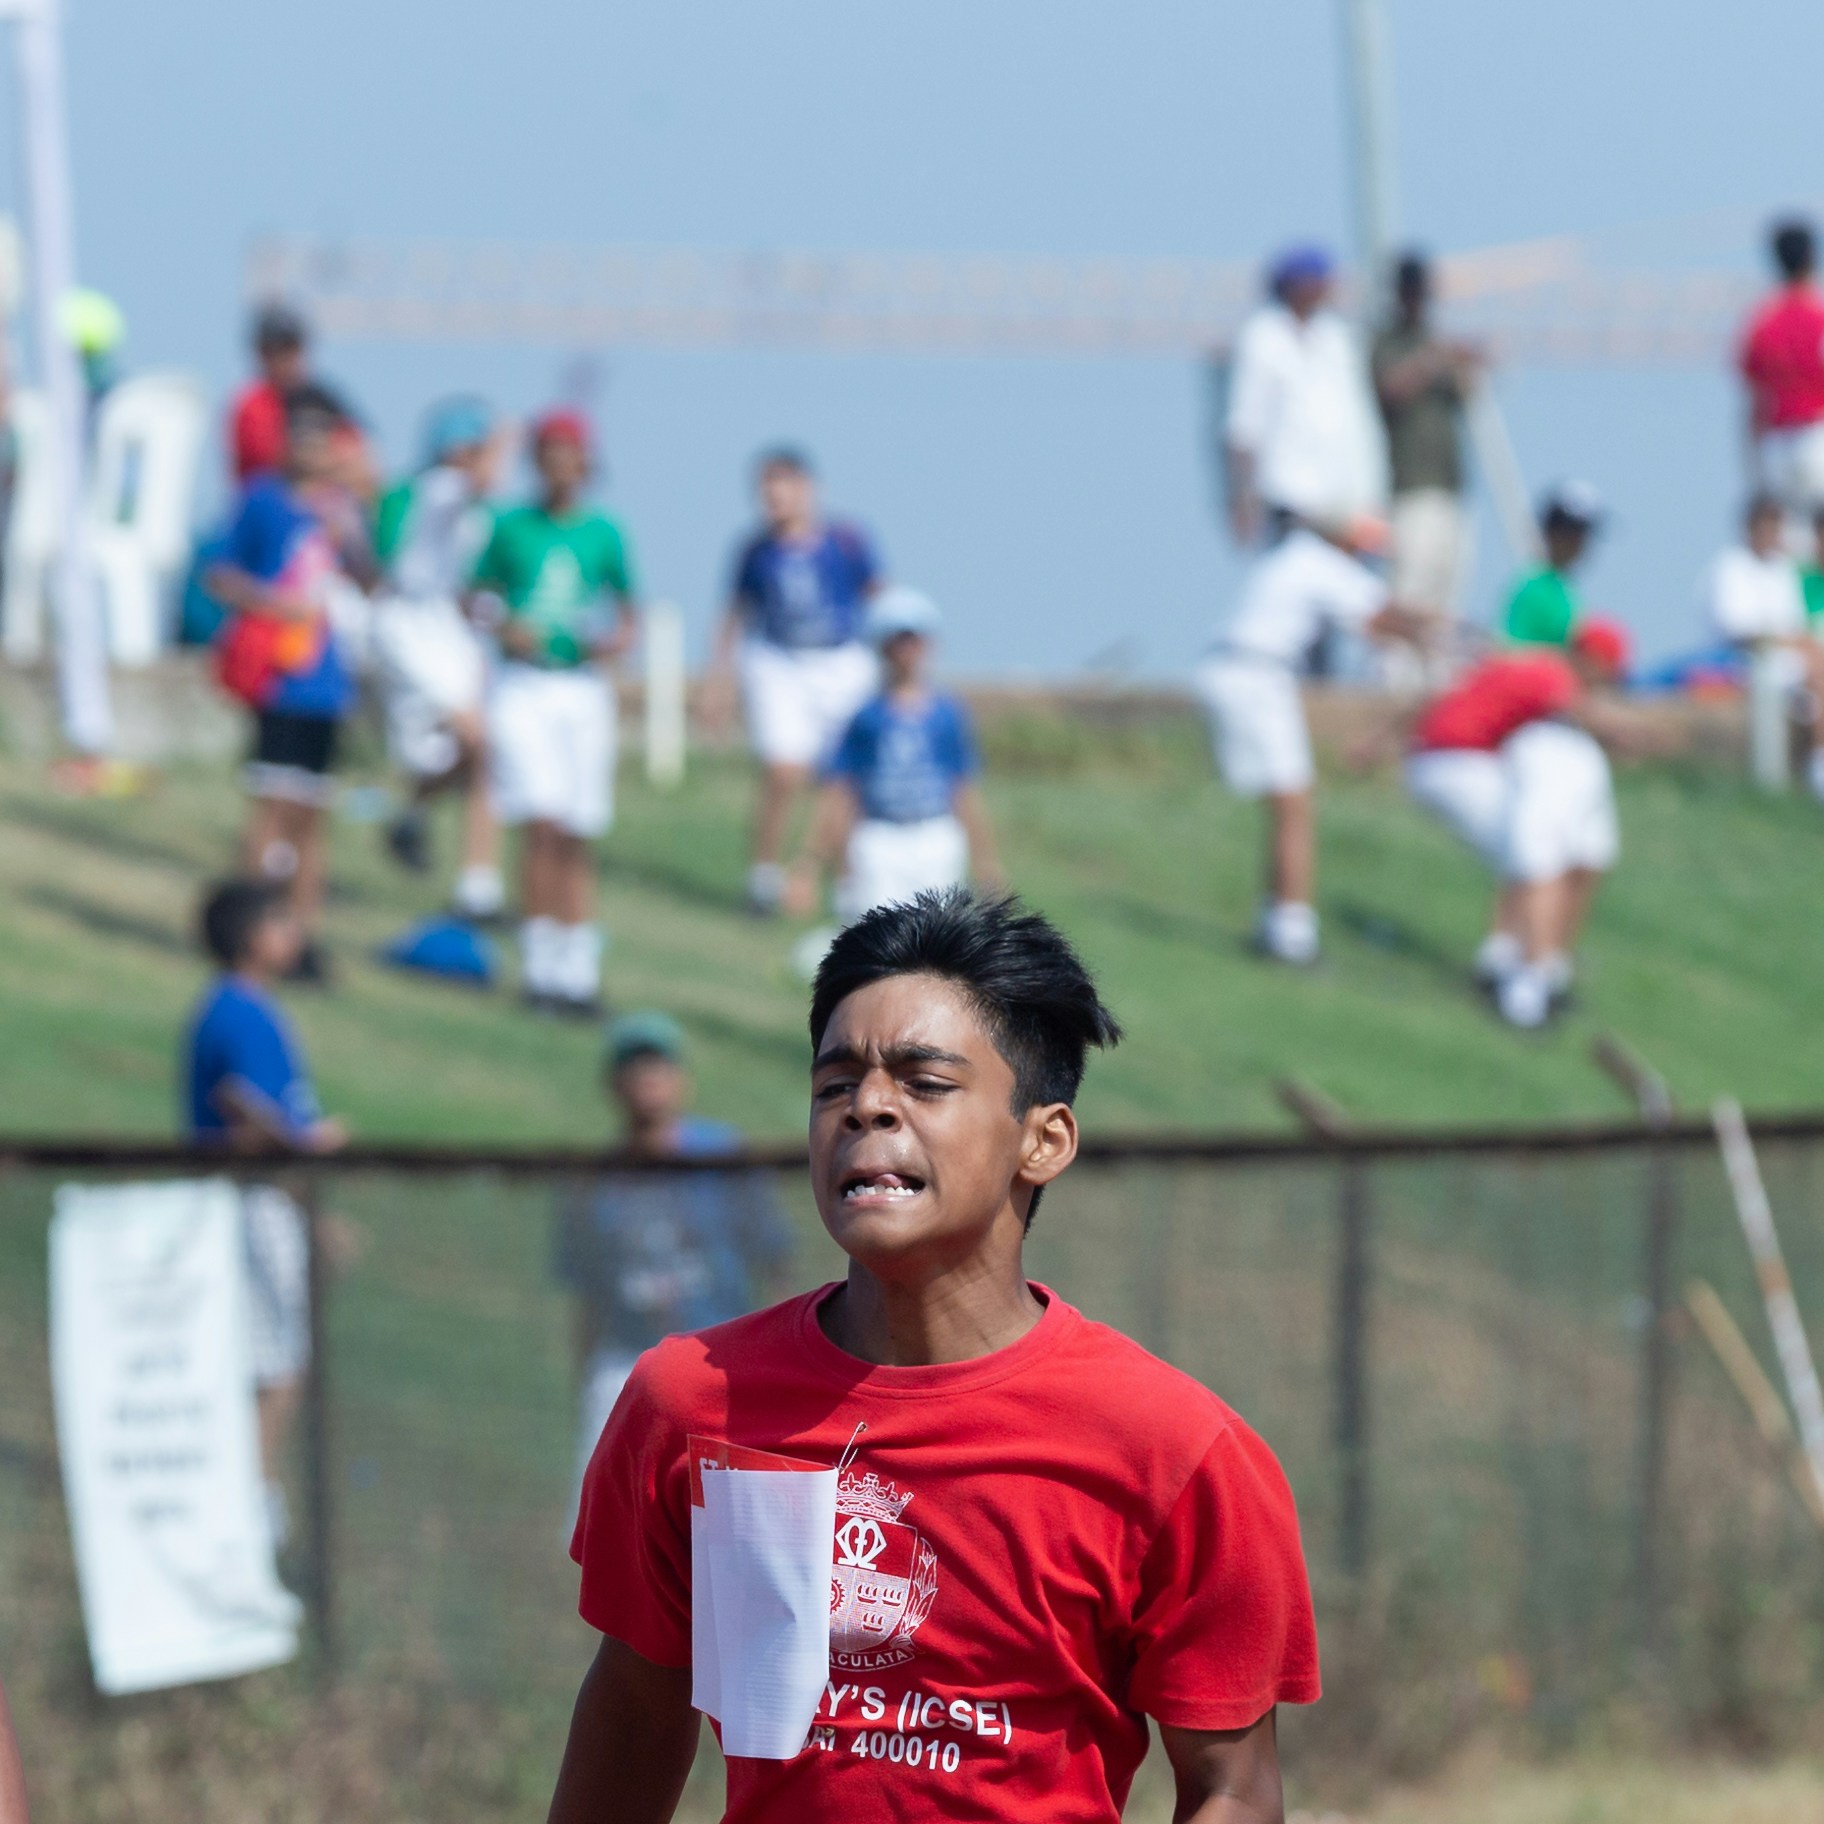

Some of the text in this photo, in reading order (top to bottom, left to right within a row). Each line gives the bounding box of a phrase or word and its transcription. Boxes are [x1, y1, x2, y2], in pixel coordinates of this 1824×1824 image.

[815, 1680, 1013, 1745] Y'S (ICSE)
[850, 1730, 960, 1773] 400010
